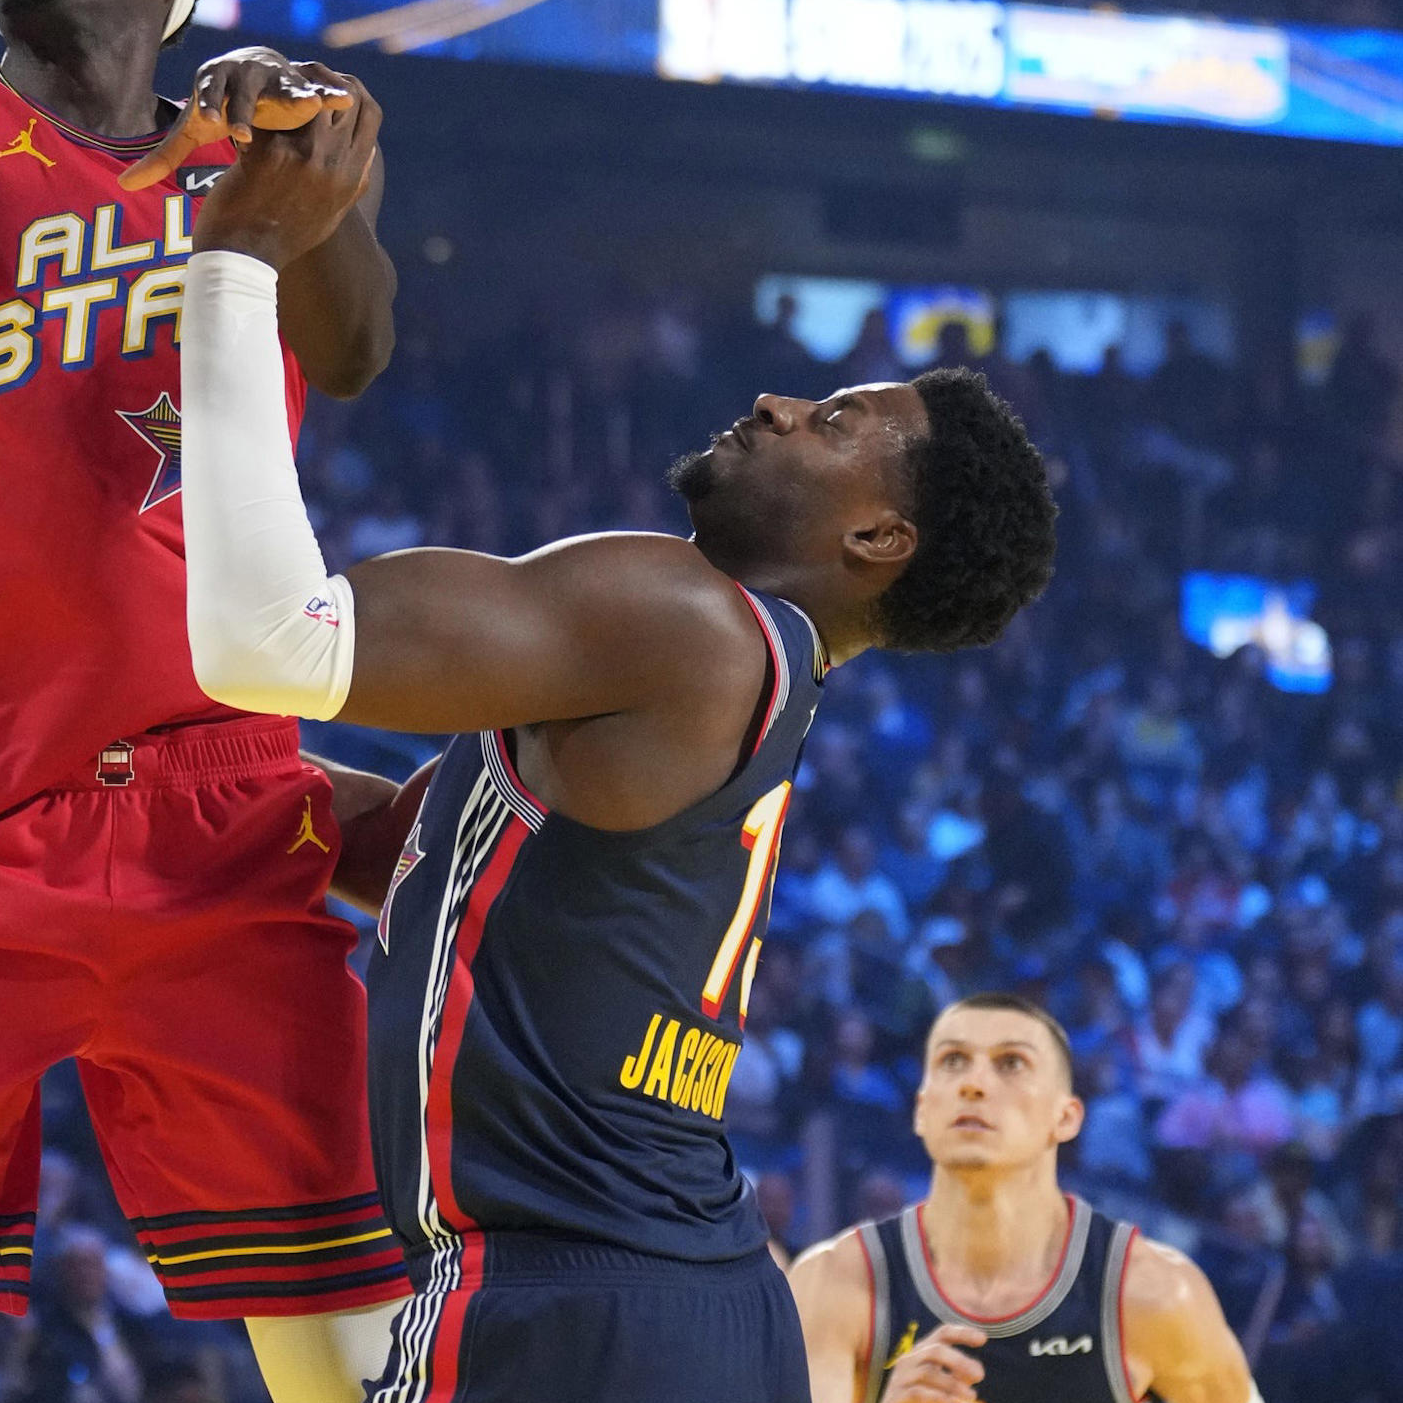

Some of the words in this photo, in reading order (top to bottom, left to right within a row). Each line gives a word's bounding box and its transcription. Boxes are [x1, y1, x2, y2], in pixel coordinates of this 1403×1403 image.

[16, 194, 195, 290] ALL
[702, 780, 792, 1031] 1
[619, 1013, 742, 1121] JACKSON
